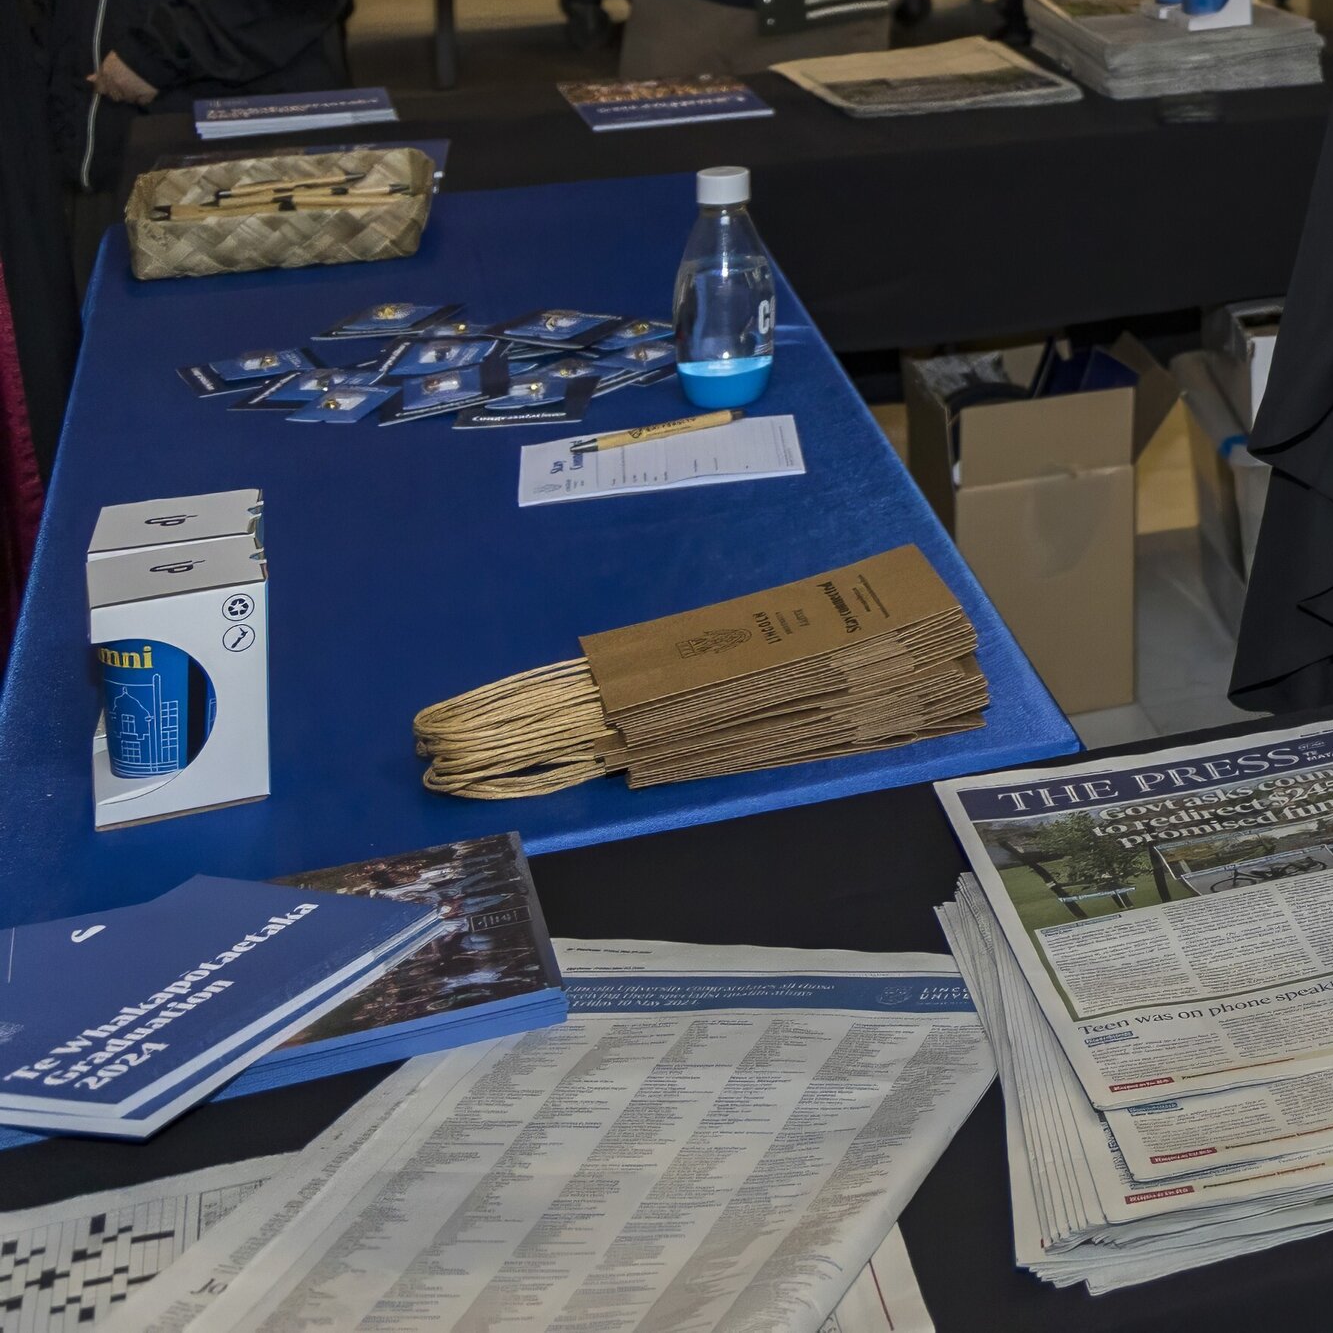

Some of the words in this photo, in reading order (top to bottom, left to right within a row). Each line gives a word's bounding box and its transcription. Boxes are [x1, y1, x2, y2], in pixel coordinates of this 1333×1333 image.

[998, 780, 1118, 812] THE
[1130, 747, 1300, 793] PRESS
[1092, 823, 1127, 838] to
[1132, 797, 1266, 830] redirect
[1100, 798, 1179, 821] Govt
[1183, 786, 1254, 808] asks
[1117, 814, 1279, 850] promised
[42, 978, 237, 1087] Graduation
[1078, 1018, 1130, 1035] Teen
[1135, 1011, 1173, 1025] was
[1178, 1008, 1204, 1021] on
[1208, 995, 1272, 1018] phone
[4, 1056, 62, 1082] Te
[74, 1041, 171, 1091] 2024
